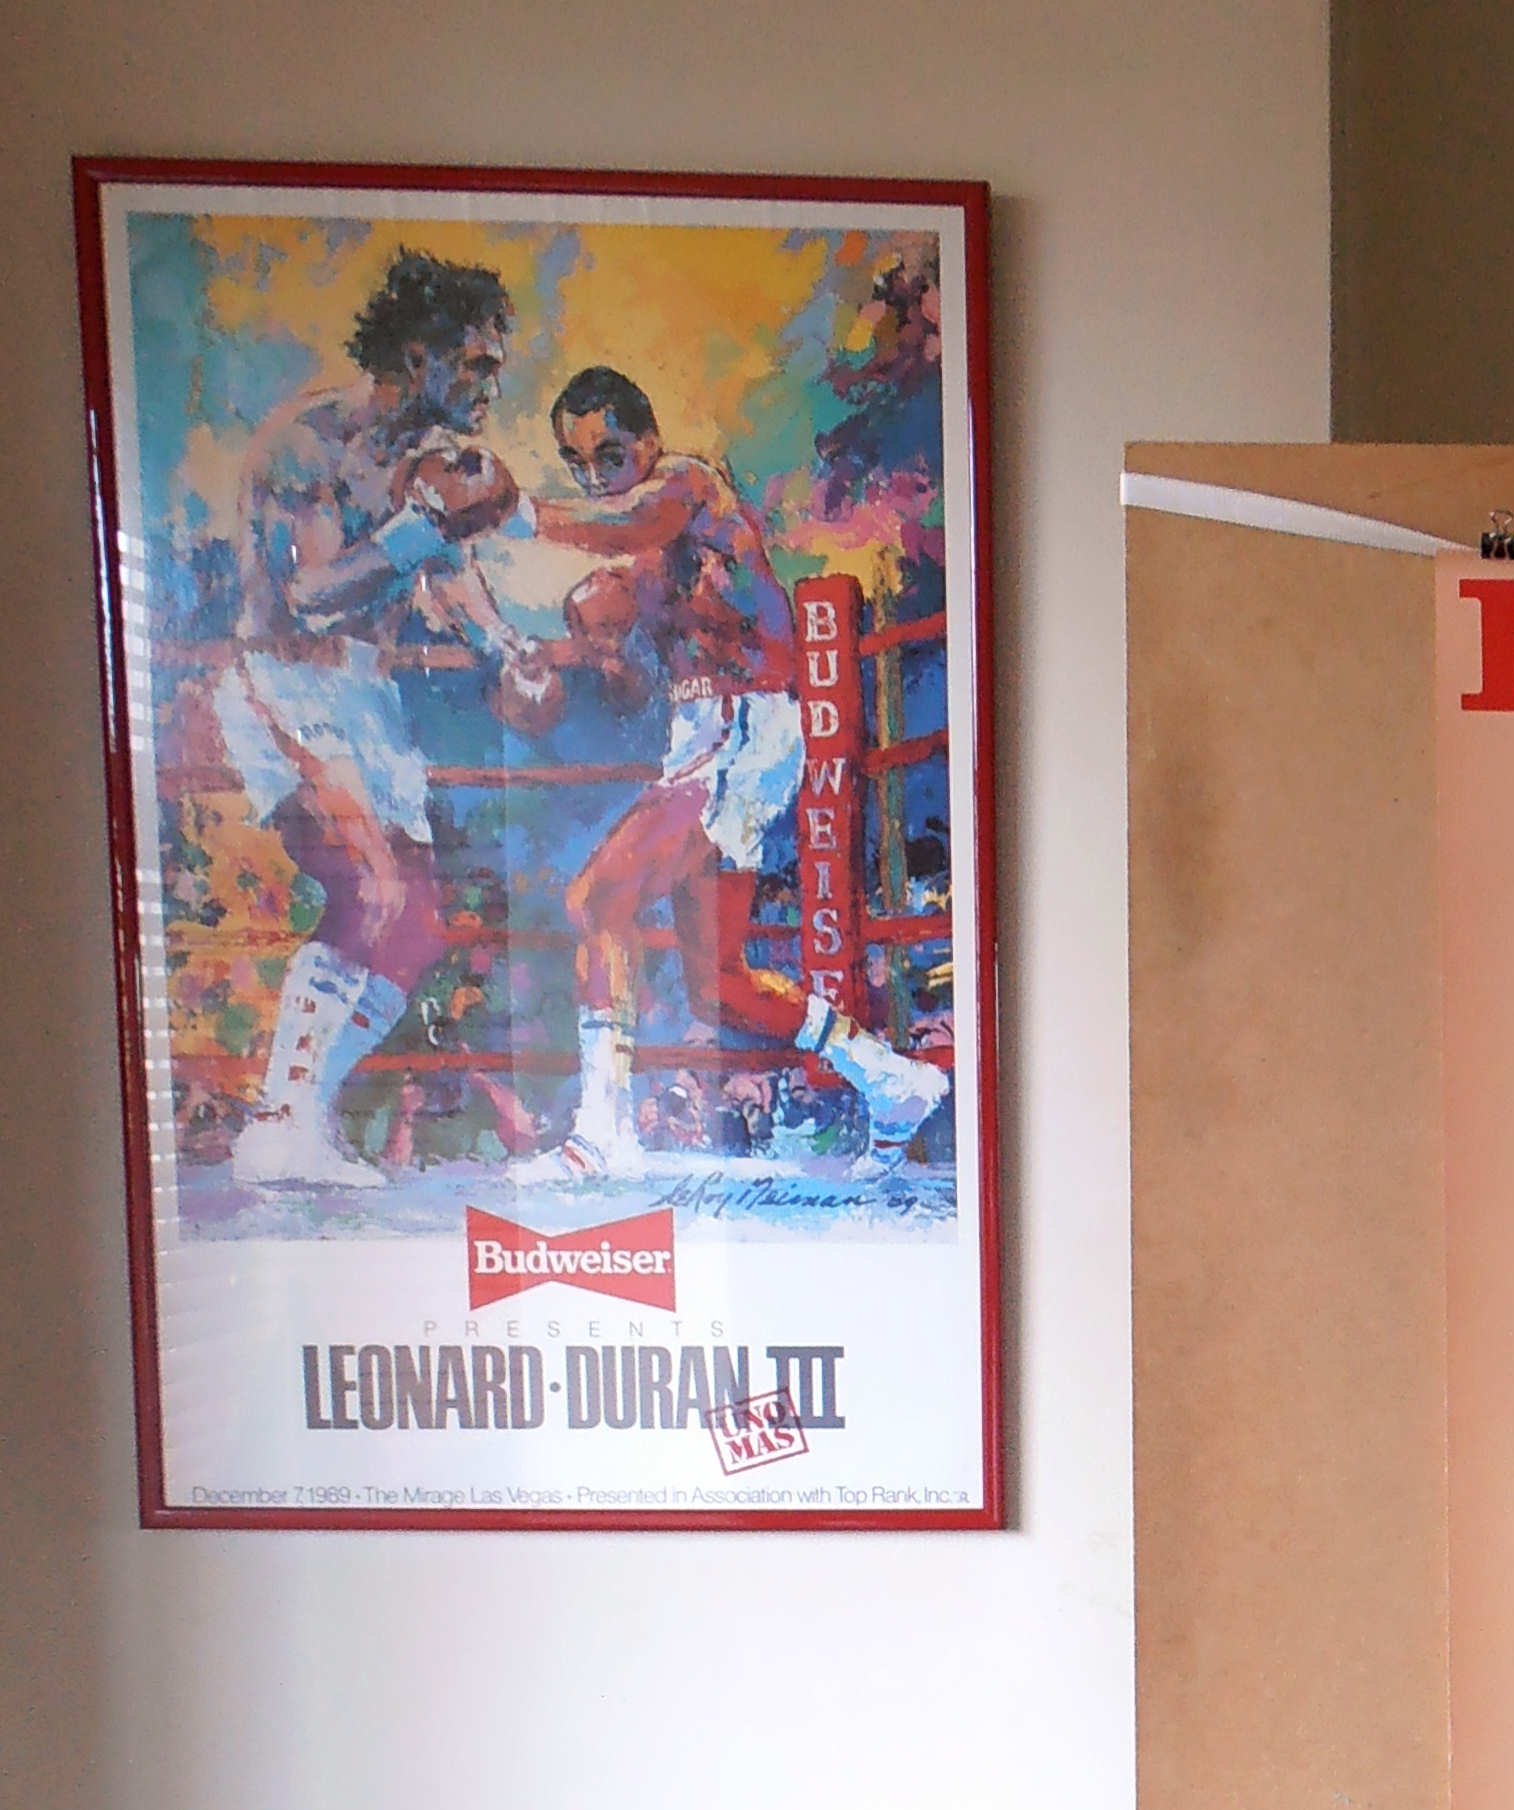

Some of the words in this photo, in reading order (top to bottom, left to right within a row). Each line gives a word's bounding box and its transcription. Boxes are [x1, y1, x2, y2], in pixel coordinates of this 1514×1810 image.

[473, 1239, 672, 1276] Budweiser
[424, 1320, 725, 1338] PRESENTS
[766, 1344, 847, 1430] III
[719, 1401, 787, 1438] UNO
[724, 1427, 796, 1465] MAS
[191, 1485, 288, 1504] December
[364, 1486, 398, 1504] The
[403, 1486, 466, 1508] Mirage
[469, 1487, 502, 1504] Las
[506, 1486, 563, 1507] Vegas
[576, 1486, 667, 1504] Presented
[672, 1486, 688, 1504] in
[692, 1486, 792, 1504] Association
[797, 1486, 831, 1504] with
[836, 1486, 868, 1506] Top
